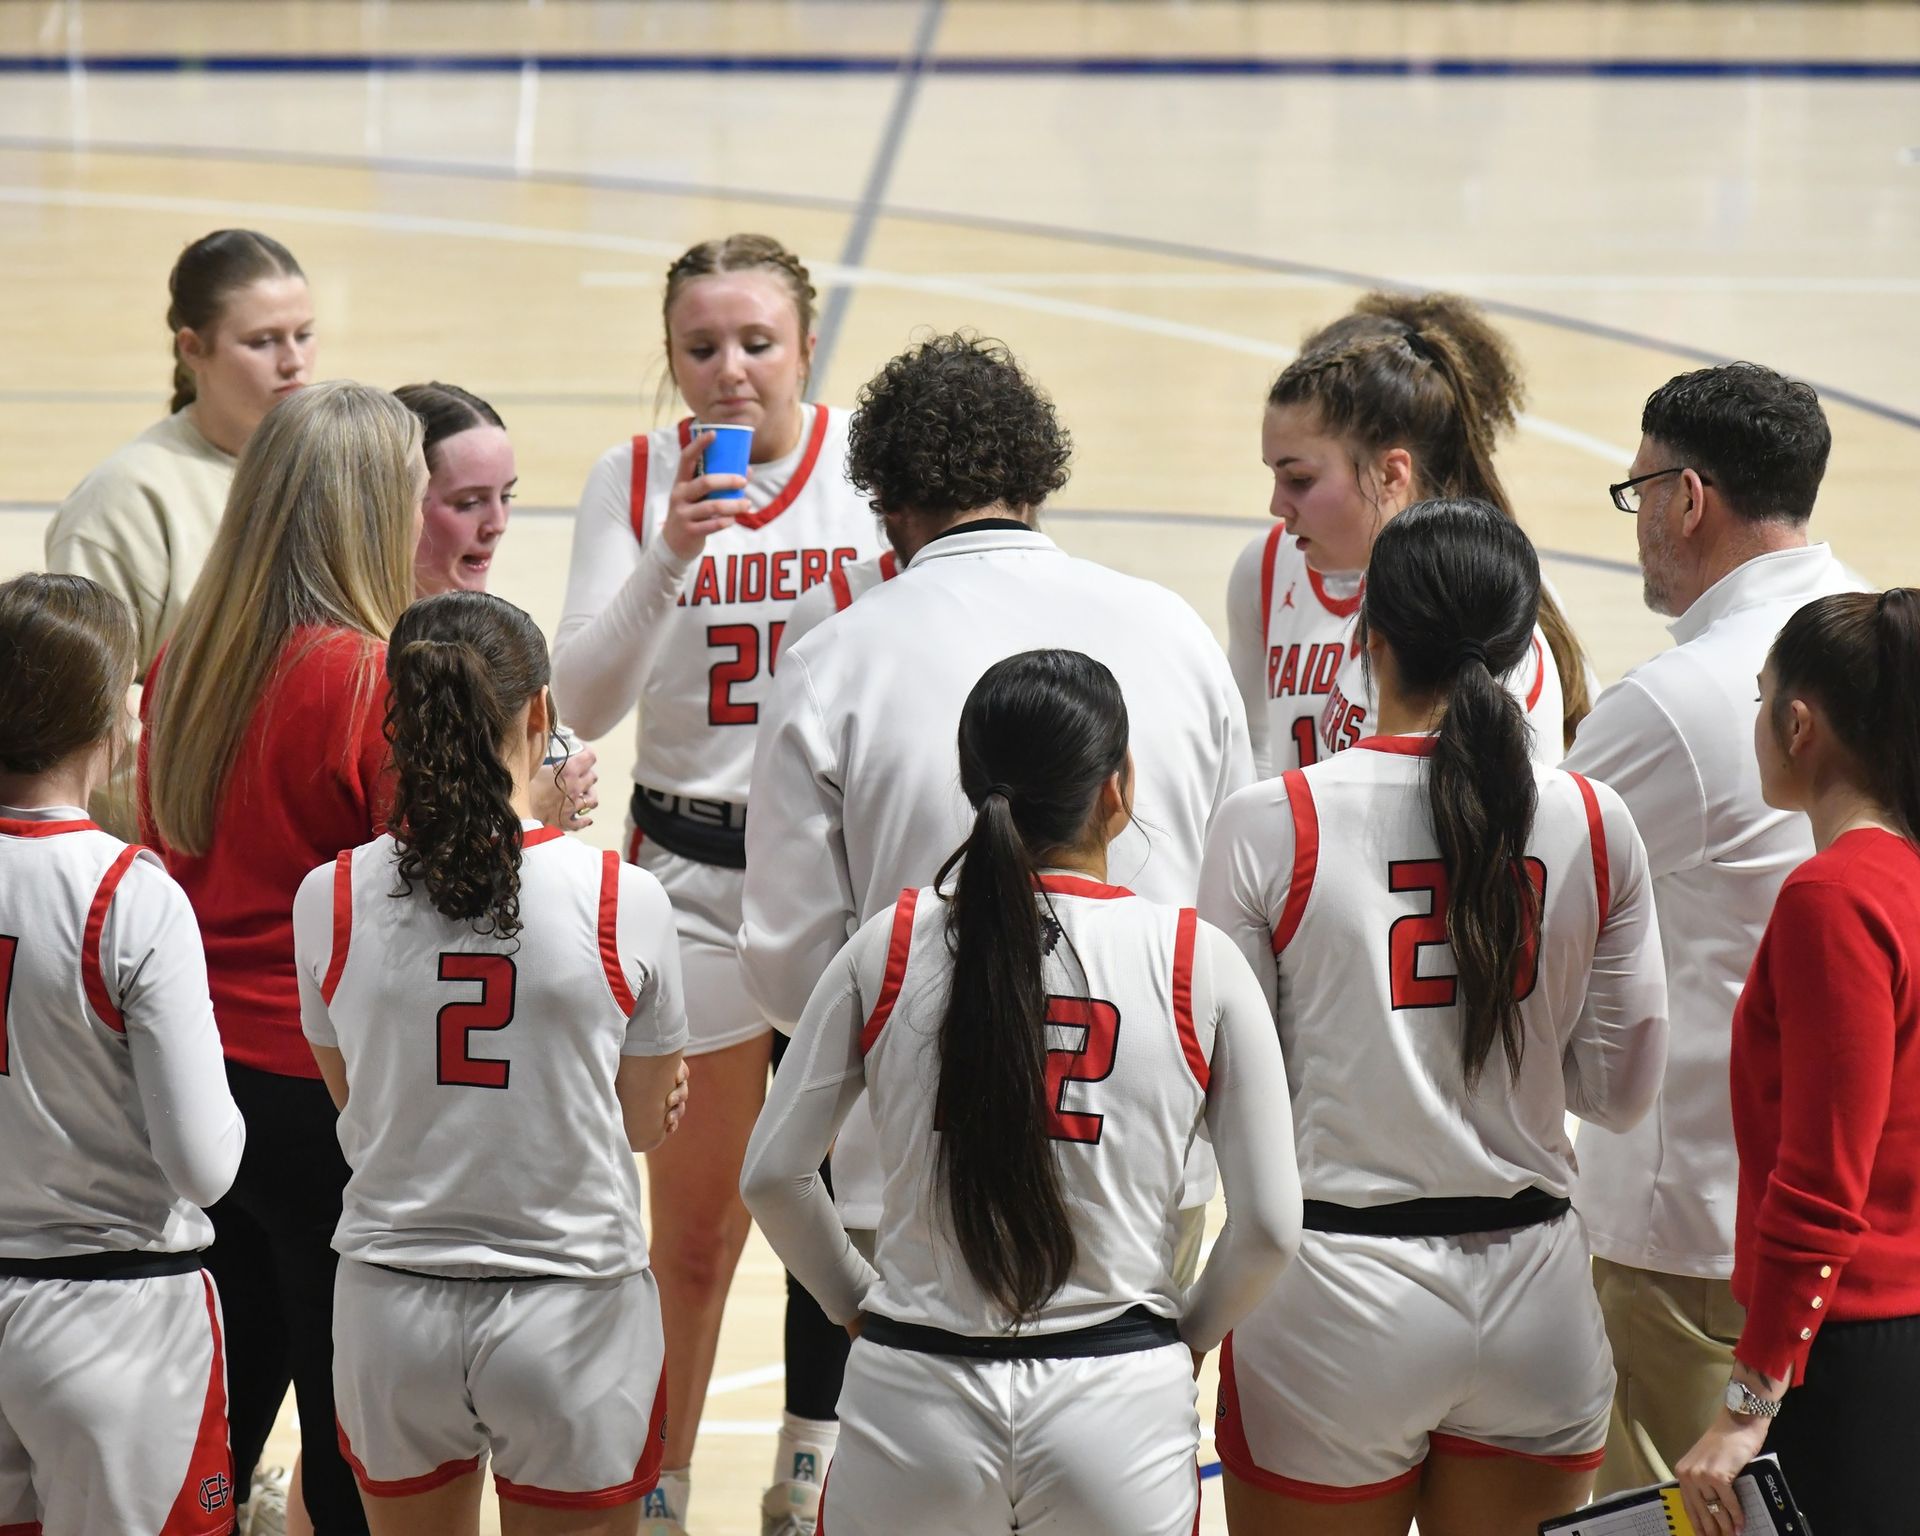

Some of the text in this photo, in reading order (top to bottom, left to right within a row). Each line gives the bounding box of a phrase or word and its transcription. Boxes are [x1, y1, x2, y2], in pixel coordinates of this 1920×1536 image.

[677, 547, 857, 606] AIDER
[707, 621, 786, 726] 2
[436, 952, 517, 1089] 2
[1764, 1474, 1783, 1505] SKLZ
